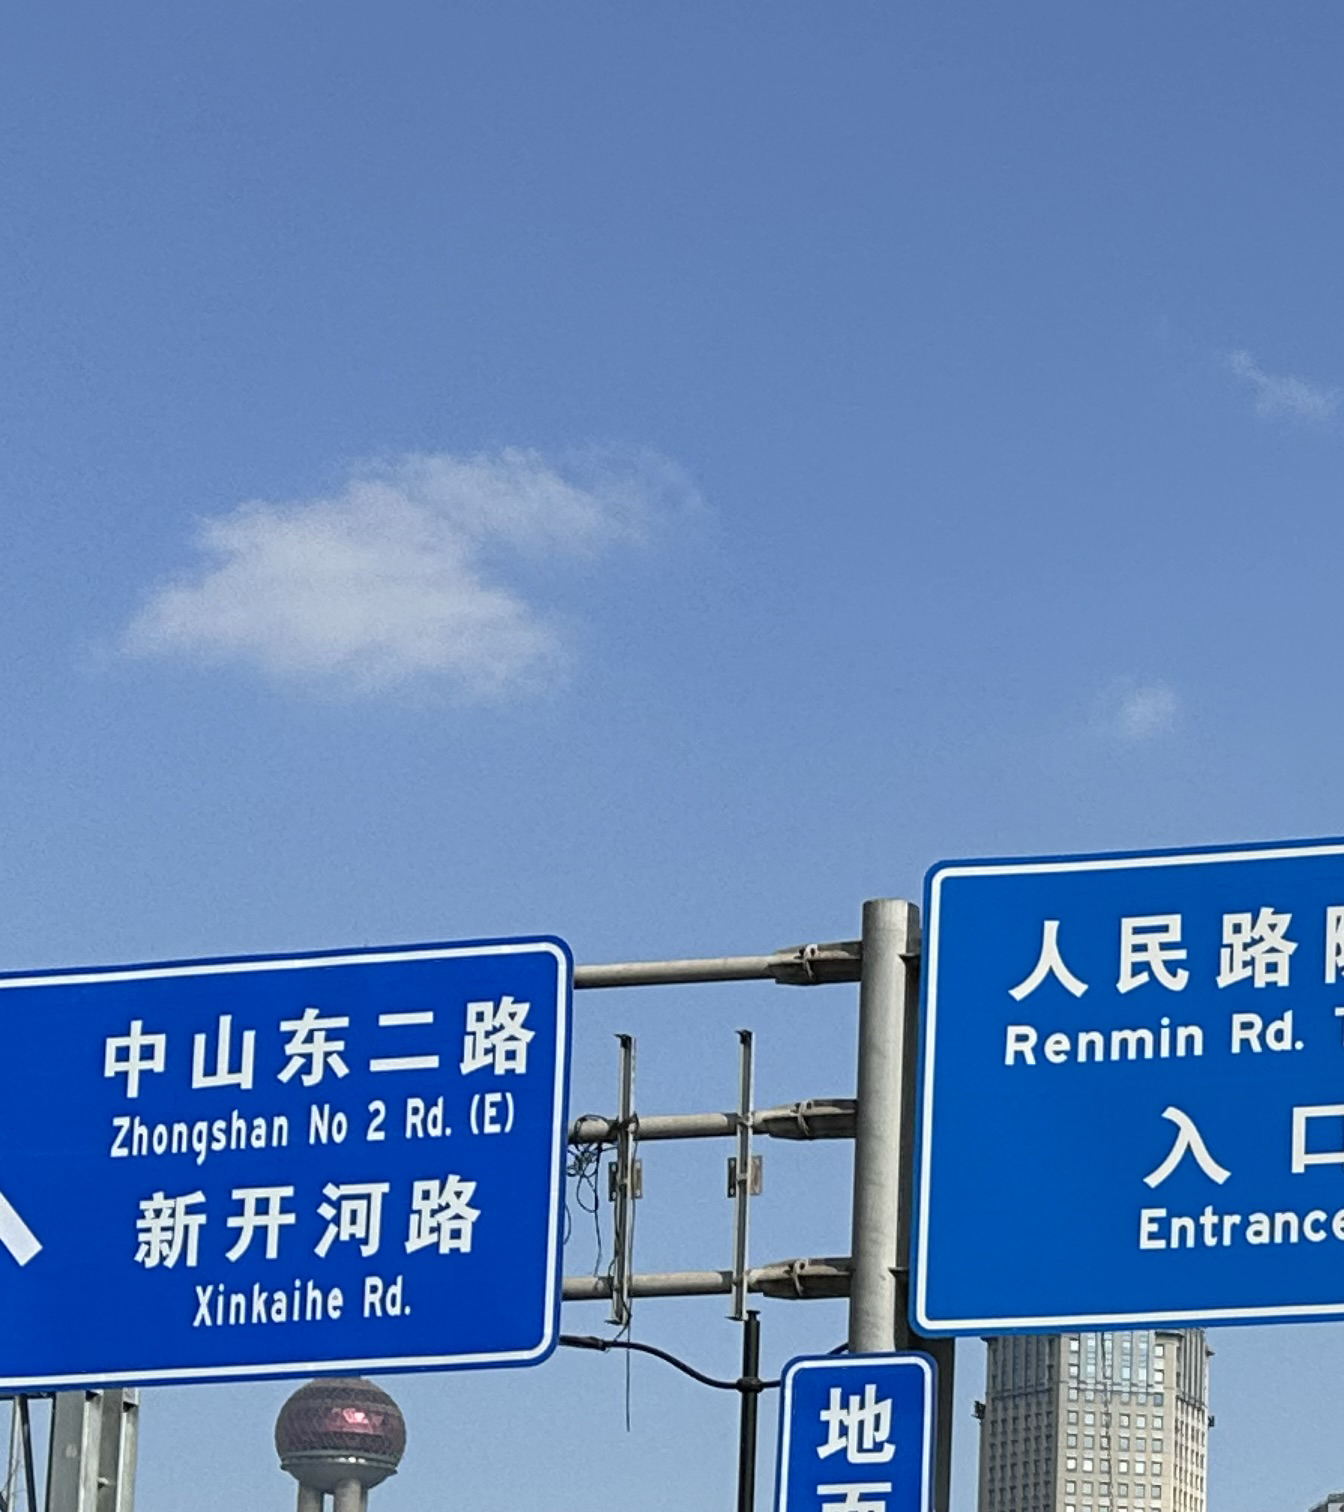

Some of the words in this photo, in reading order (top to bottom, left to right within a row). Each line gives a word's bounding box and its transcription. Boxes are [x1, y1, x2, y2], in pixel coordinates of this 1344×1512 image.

[104, 995, 536, 1098] 中山东二路
[1004, 1016, 1203, 1065] Renmin
[1231, 1010, 1304, 1054] Rd.
[110, 1109, 289, 1165] Zhongshan
[309, 1104, 348, 1145] No
[366, 1100, 386, 1141] 2
[405, 1096, 452, 1139] Rd.
[470, 1092, 514, 1135] (E)
[134, 1174, 481, 1269] 新开河路
[193, 1279, 344, 1327] Xinkaihe
[363, 1275, 411, 1318] Rd.
